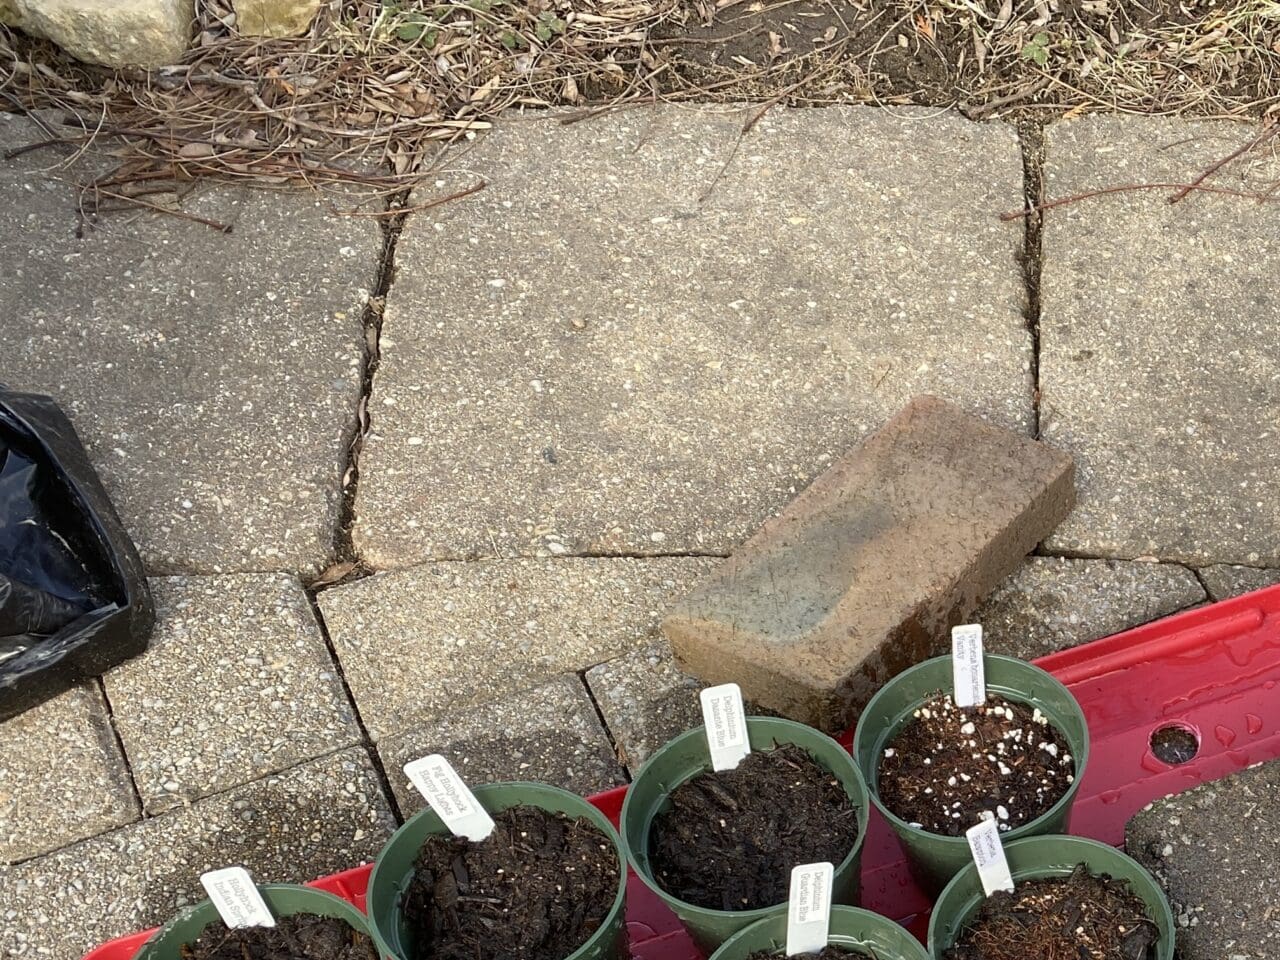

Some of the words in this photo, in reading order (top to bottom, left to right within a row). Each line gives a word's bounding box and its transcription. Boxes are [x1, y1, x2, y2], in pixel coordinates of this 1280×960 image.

[723, 695, 737, 739] Delphinium
[418, 770, 439, 793] Happy
[434, 792, 454, 816] Lights
[440, 777, 468, 813] Hollyhock
